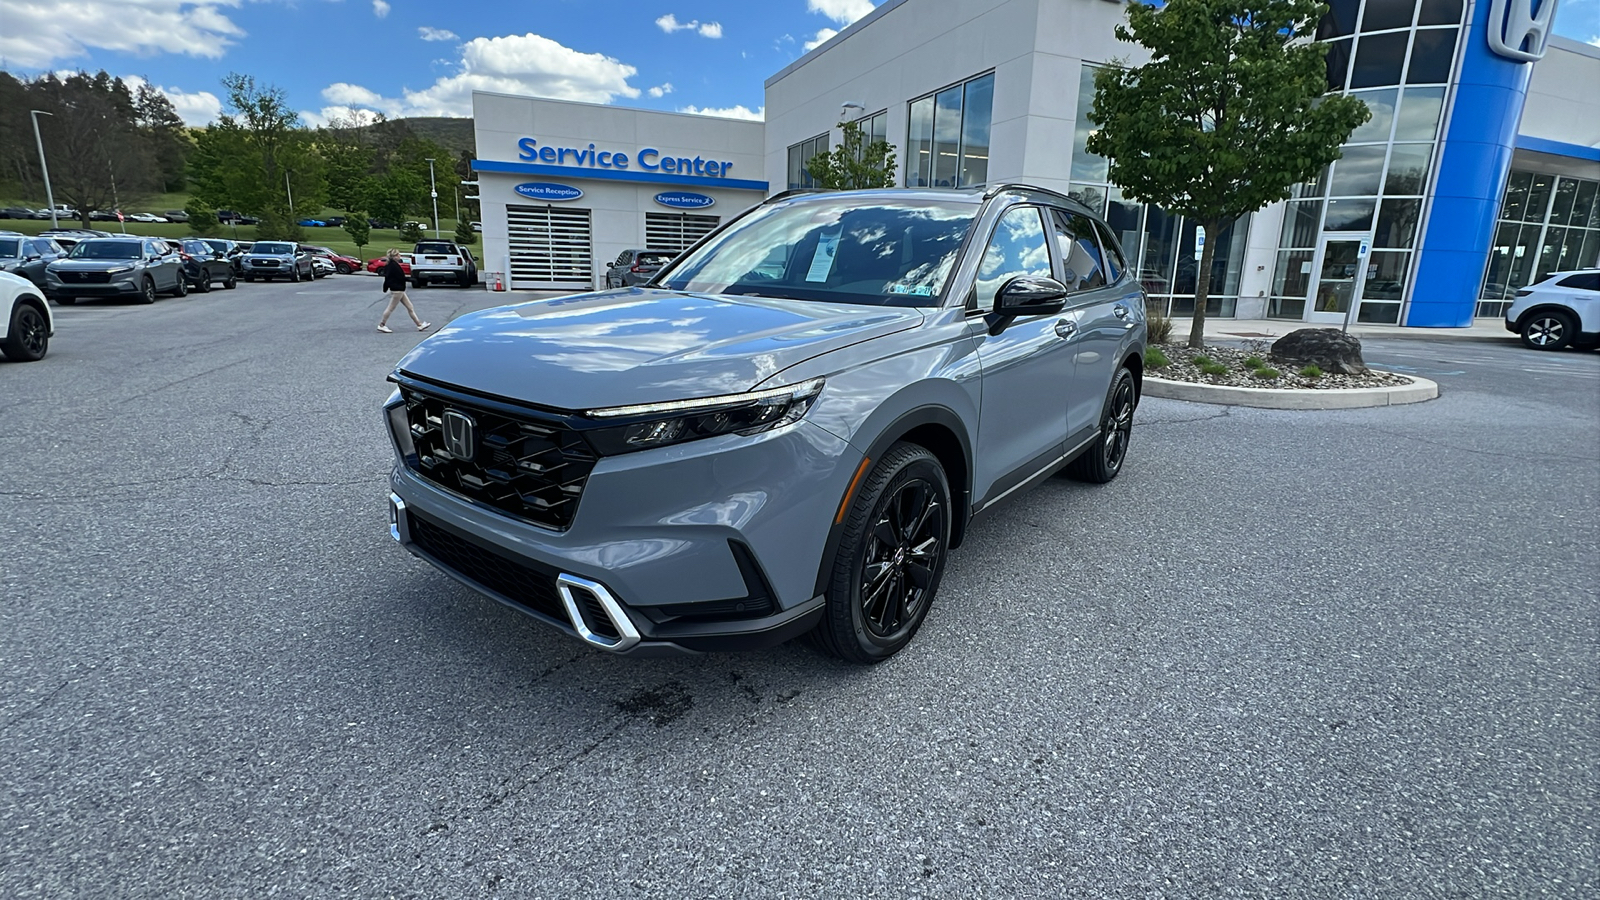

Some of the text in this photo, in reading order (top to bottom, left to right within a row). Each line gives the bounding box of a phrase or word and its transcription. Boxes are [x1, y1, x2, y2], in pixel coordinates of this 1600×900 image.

[518, 138, 733, 177] Service Center
[518, 186, 579, 196] Service Reception
[657, 195, 703, 204] Express Service
